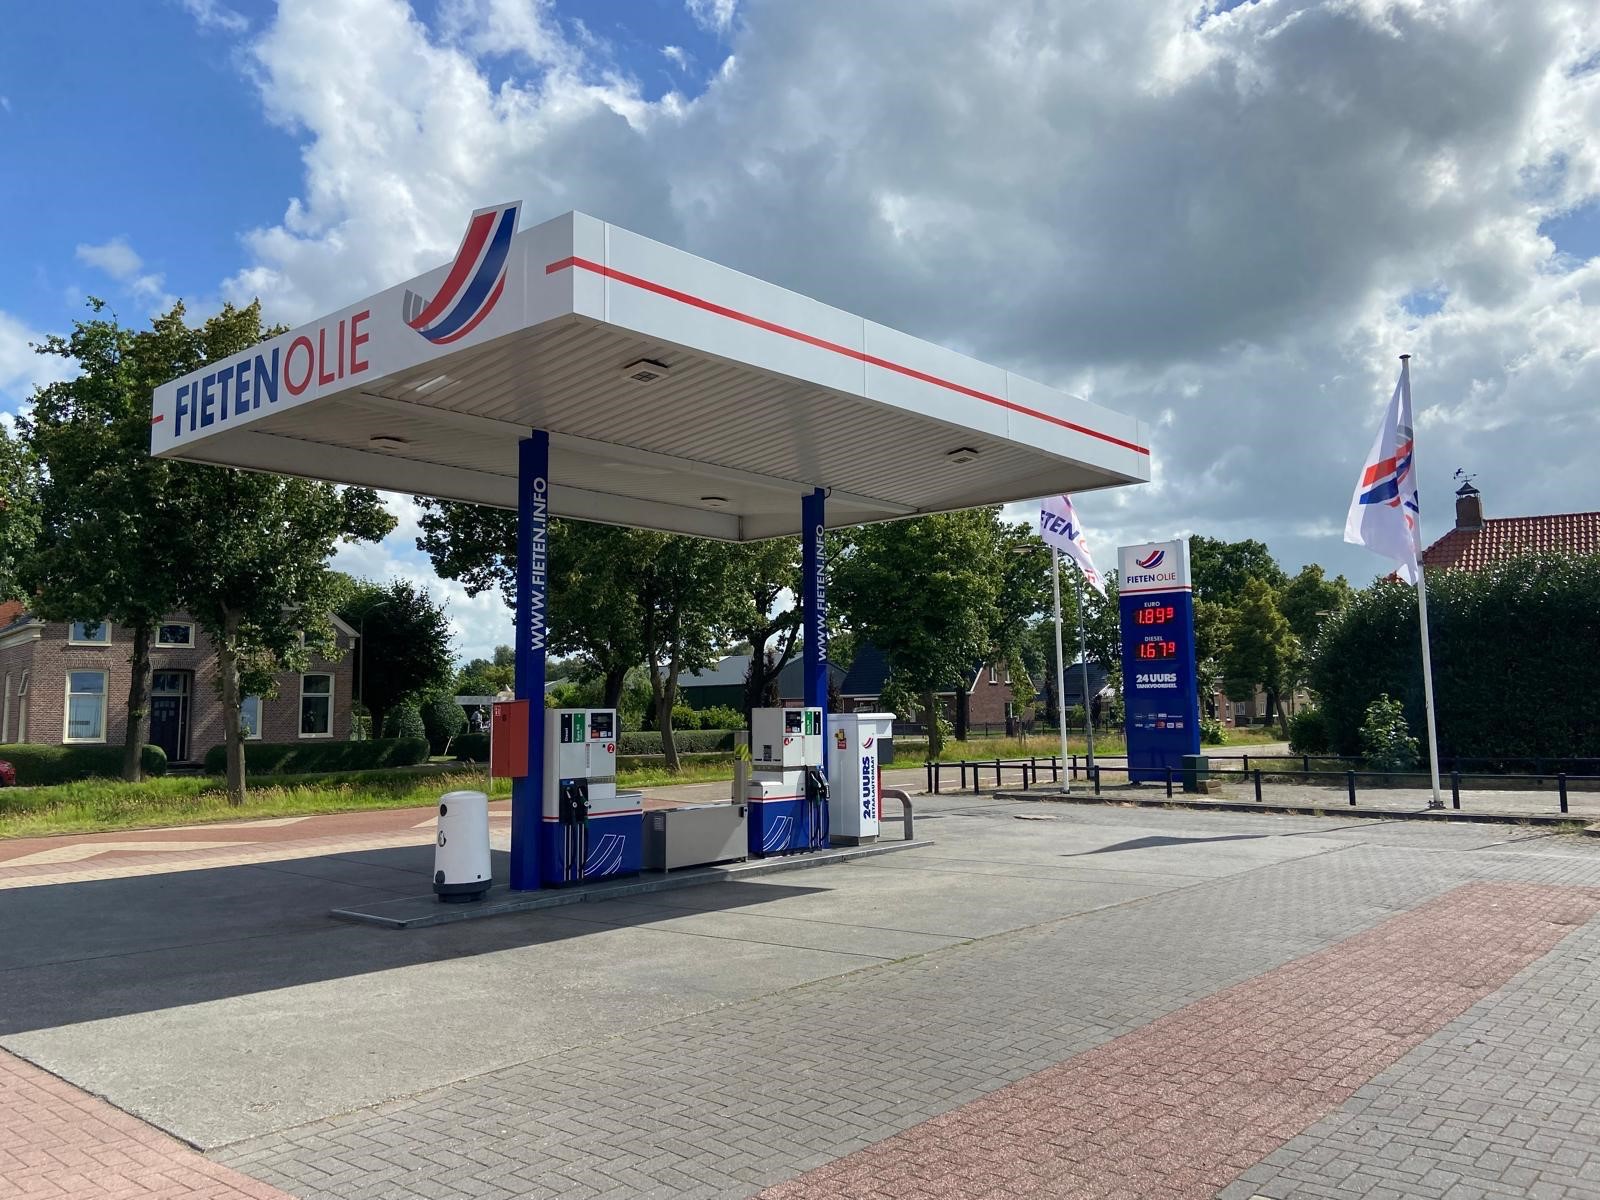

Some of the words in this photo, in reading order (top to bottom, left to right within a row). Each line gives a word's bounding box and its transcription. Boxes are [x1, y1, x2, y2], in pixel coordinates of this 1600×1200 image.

[530, 476, 547, 651] WWW.FIETEN.INFO
[816, 524, 827, 662] WWW.FIETEN.INFO
[1136, 673, 1149, 683] 24
[1149, 673, 1177, 682] UURS
[862, 756, 871, 798] UURS
[863, 799, 871, 819] 24
